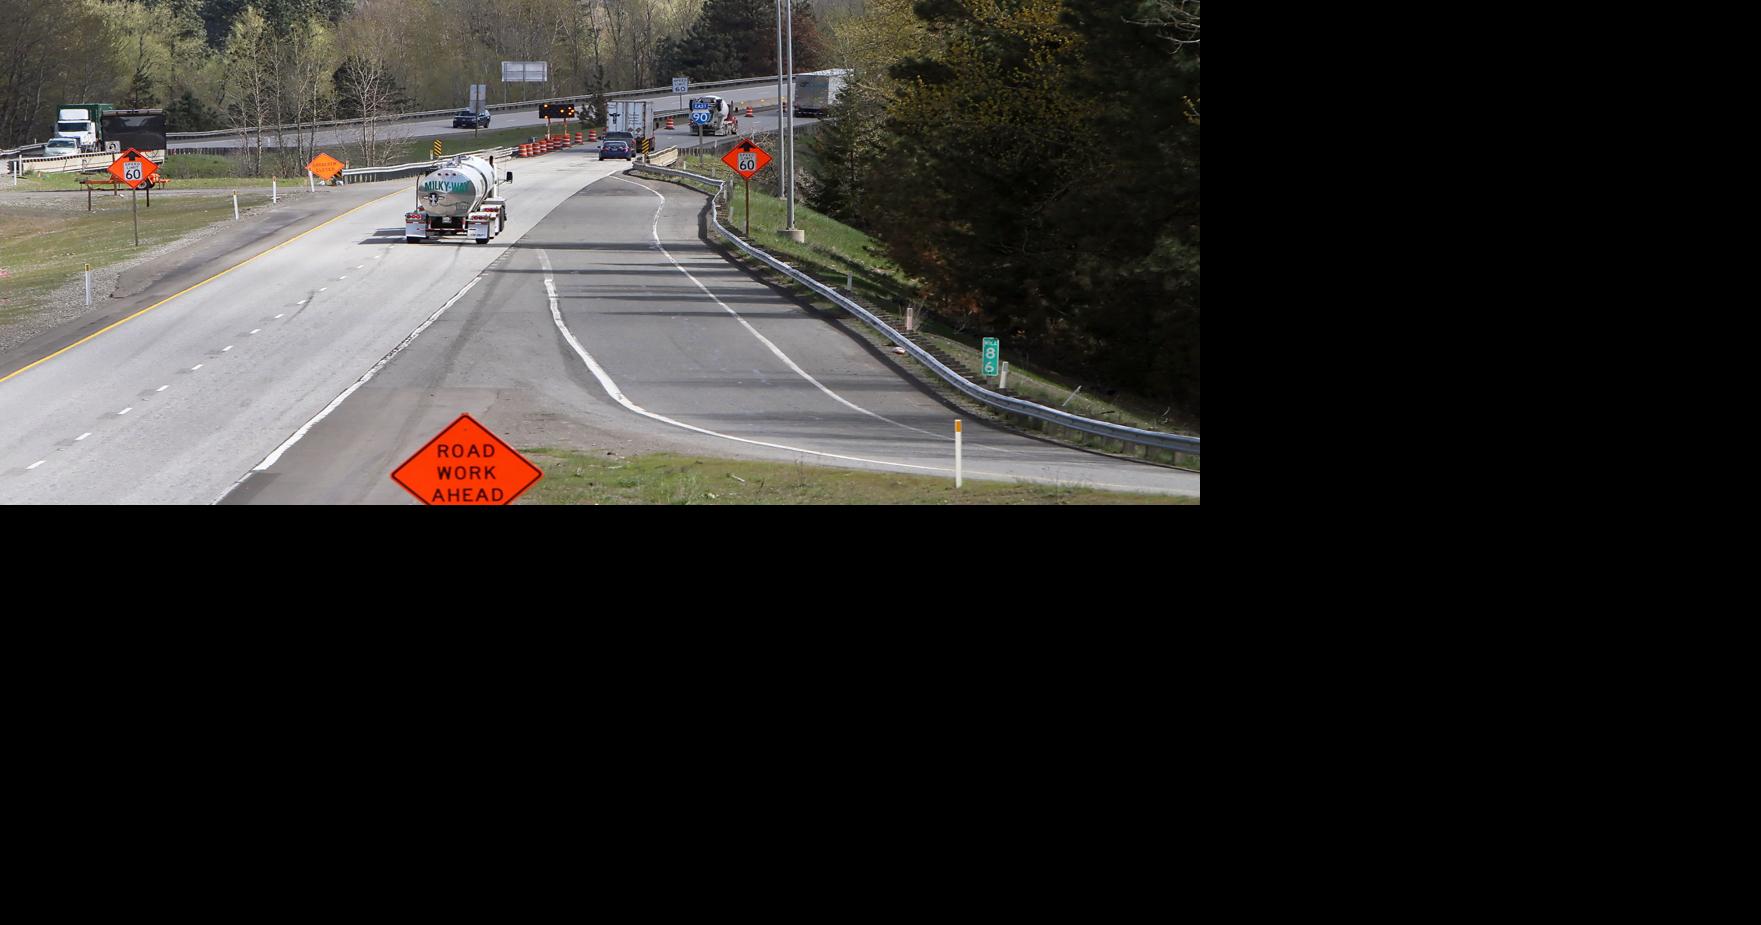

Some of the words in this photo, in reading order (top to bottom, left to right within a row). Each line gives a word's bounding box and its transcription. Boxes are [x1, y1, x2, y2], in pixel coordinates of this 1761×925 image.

[692, 113, 708, 122] 90
[739, 160, 755, 170] 60
[125, 169, 141, 180] 60
[437, 444, 495, 458] ROAD
[437, 466, 496, 480] WORK
[432, 488, 504, 502] AHEAD
